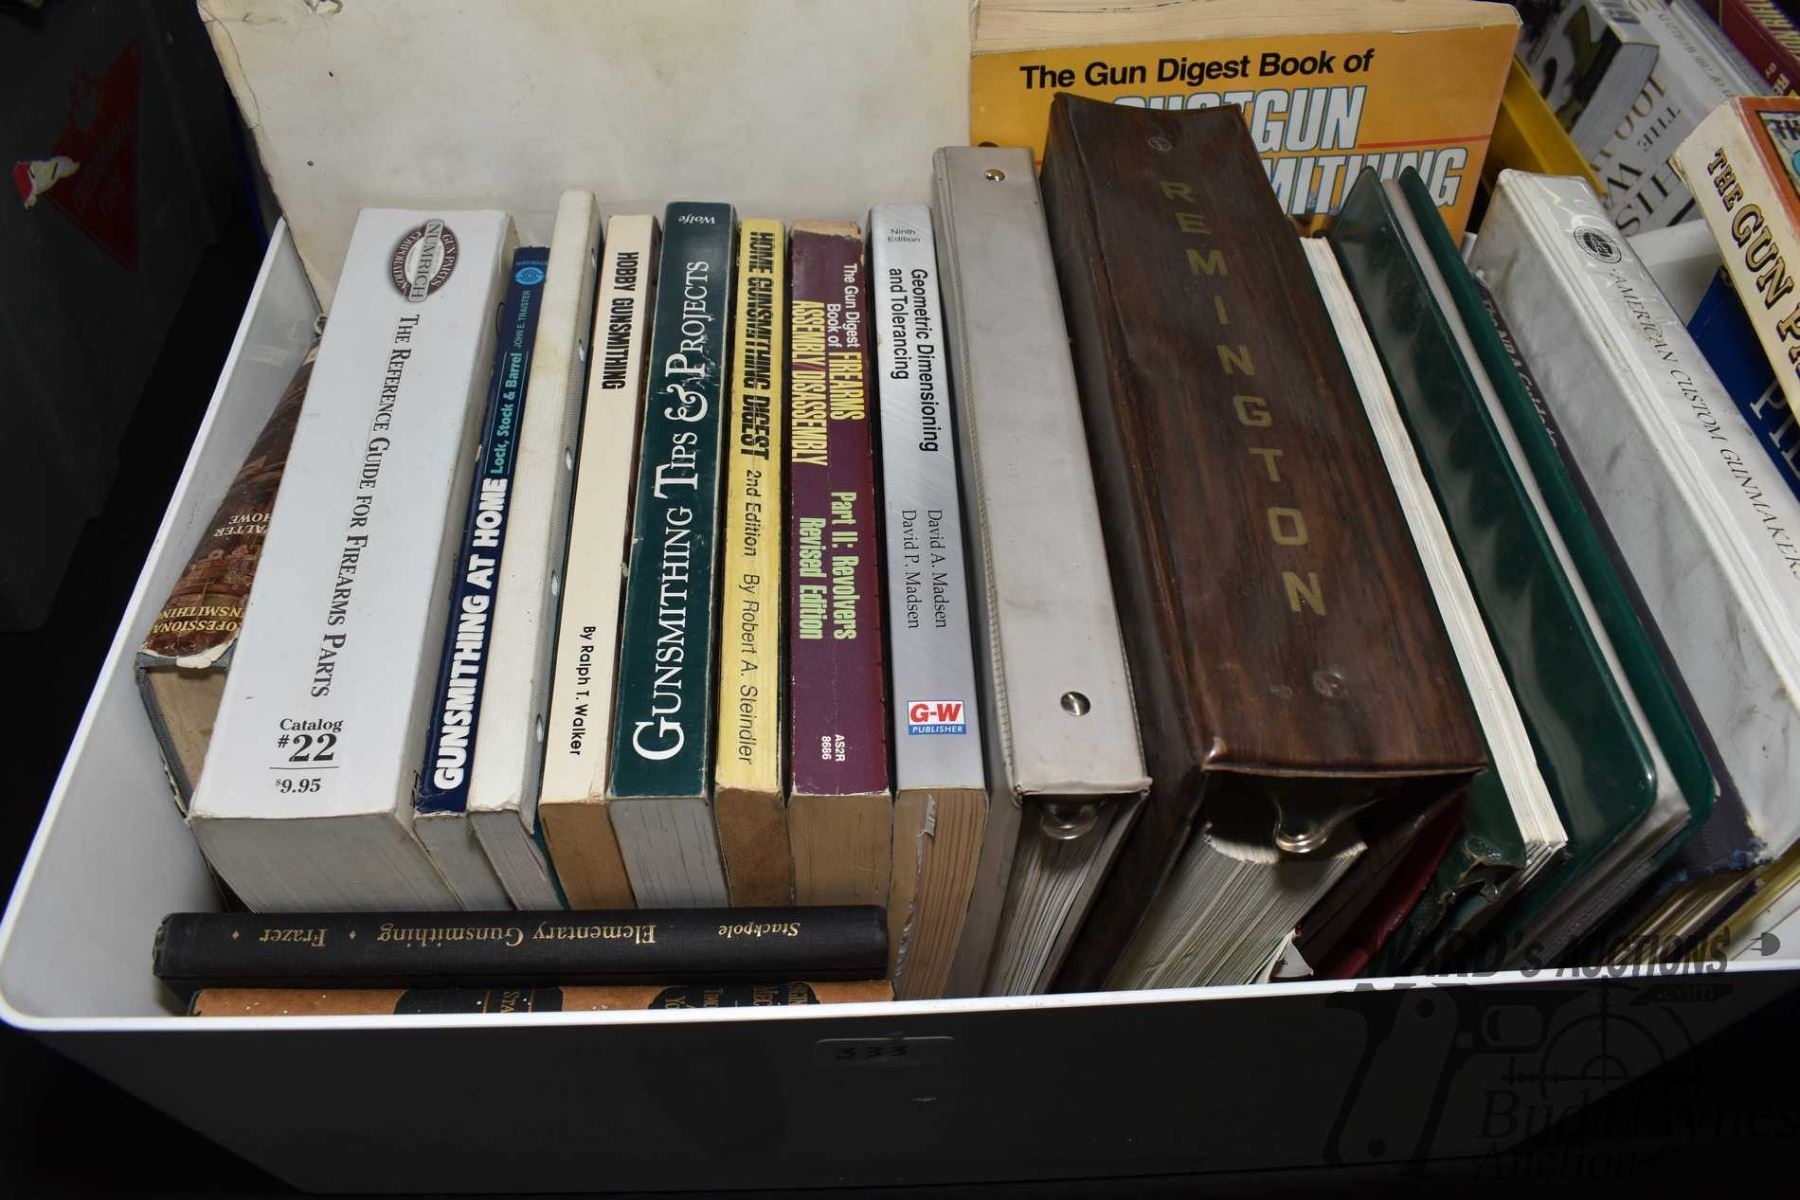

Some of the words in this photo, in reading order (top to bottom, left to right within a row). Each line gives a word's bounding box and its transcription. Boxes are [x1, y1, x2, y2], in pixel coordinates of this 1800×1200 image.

[1020, 64, 1075, 89] The
[1085, 61, 1147, 86] Gun
[1158, 55, 1250, 92] Digest
[1259, 49, 1334, 76] Book
[1343, 48, 1375, 73] of
[678, 214, 716, 225] Wolfe
[1707, 148, 1744, 212] THE
[1731, 203, 1795, 310] GUN
[412, 223, 441, 297] NUMRICH
[614, 251, 639, 292] HOBBY
[749, 232, 774, 274] HOME
[843, 263, 857, 282] The
[845, 285, 859, 303] Gun
[889, 268, 902, 293] and
[665, 261, 710, 378] PROJECTS
[827, 304, 841, 333] Book
[910, 269, 929, 340] Geometric
[395, 314, 420, 343] THE
[515, 329, 524, 348] JOHN
[602, 297, 634, 389] GUNSMITHING
[743, 276, 774, 390] GUNSMITHING
[827, 335, 842, 348] of
[842, 306, 860, 348] Digest
[891, 296, 912, 380] Tolerancing
[505, 353, 522, 388] Barrel
[1608, 268, 1679, 364] AMERICAN
[1670, 367, 1728, 442] CUSTOM
[373, 349, 412, 431] REFERENCE
[503, 386, 515, 399] &
[664, 383, 708, 422] &
[829, 352, 865, 421] FIREARMS
[917, 344, 942, 452] Dimensioning
[1159, 181, 1327, 615] REMINGTON
[497, 402, 514, 437] Stock
[740, 393, 770, 460] DIGEST
[359, 437, 391, 489] GUIDE
[490, 440, 510, 474] Lock,
[654, 431, 698, 499] TIPS
[745, 470, 762, 497] 2nd
[350, 495, 373, 528] FOR
[472, 478, 508, 548] HOME
[744, 500, 761, 557] Edition
[831, 492, 857, 525] Part
[213, 525, 268, 537] ALTER
[799, 517, 827, 578] Revised
[902, 510, 919, 550] David
[928, 509, 944, 549] David
[327, 534, 369, 626] FIREARMS
[467, 554, 496, 589] AT
[905, 555, 920, 568] P.
[931, 552, 945, 569] A.
[739, 574, 760, 593] By
[832, 555, 860, 640] Revolvers
[905, 572, 921, 629] Madsen
[931, 573, 947, 628] Madsen
[740, 600, 760, 653] Robert
[799, 585, 827, 640] Edition
[580, 626, 596, 641] By
[632, 506, 693, 760] GUNSMITHING
[310, 633, 347, 697] PARTS
[576, 645, 594, 686] Ralph
[741, 660, 758, 679] A.
[433, 594, 490, 790] GUNSMITHING
[575, 689, 590, 701] T.
[279, 718, 344, 732] Catalog
[570, 704, 588, 756] Walker
[738, 685, 758, 764] Steindler
[910, 703, 961, 722] G-W
[912, 725, 963, 733] PUBLISHER
[277, 733, 337, 762] #22
[835, 734, 845, 762] AS2R
[275, 778, 322, 793] $9.95
[259, 928, 329, 948] Frazer
[377, 923, 524, 947] Gunsmithing
[533, 921, 657, 945] Elementary
[718, 921, 801, 942] Stackpole
